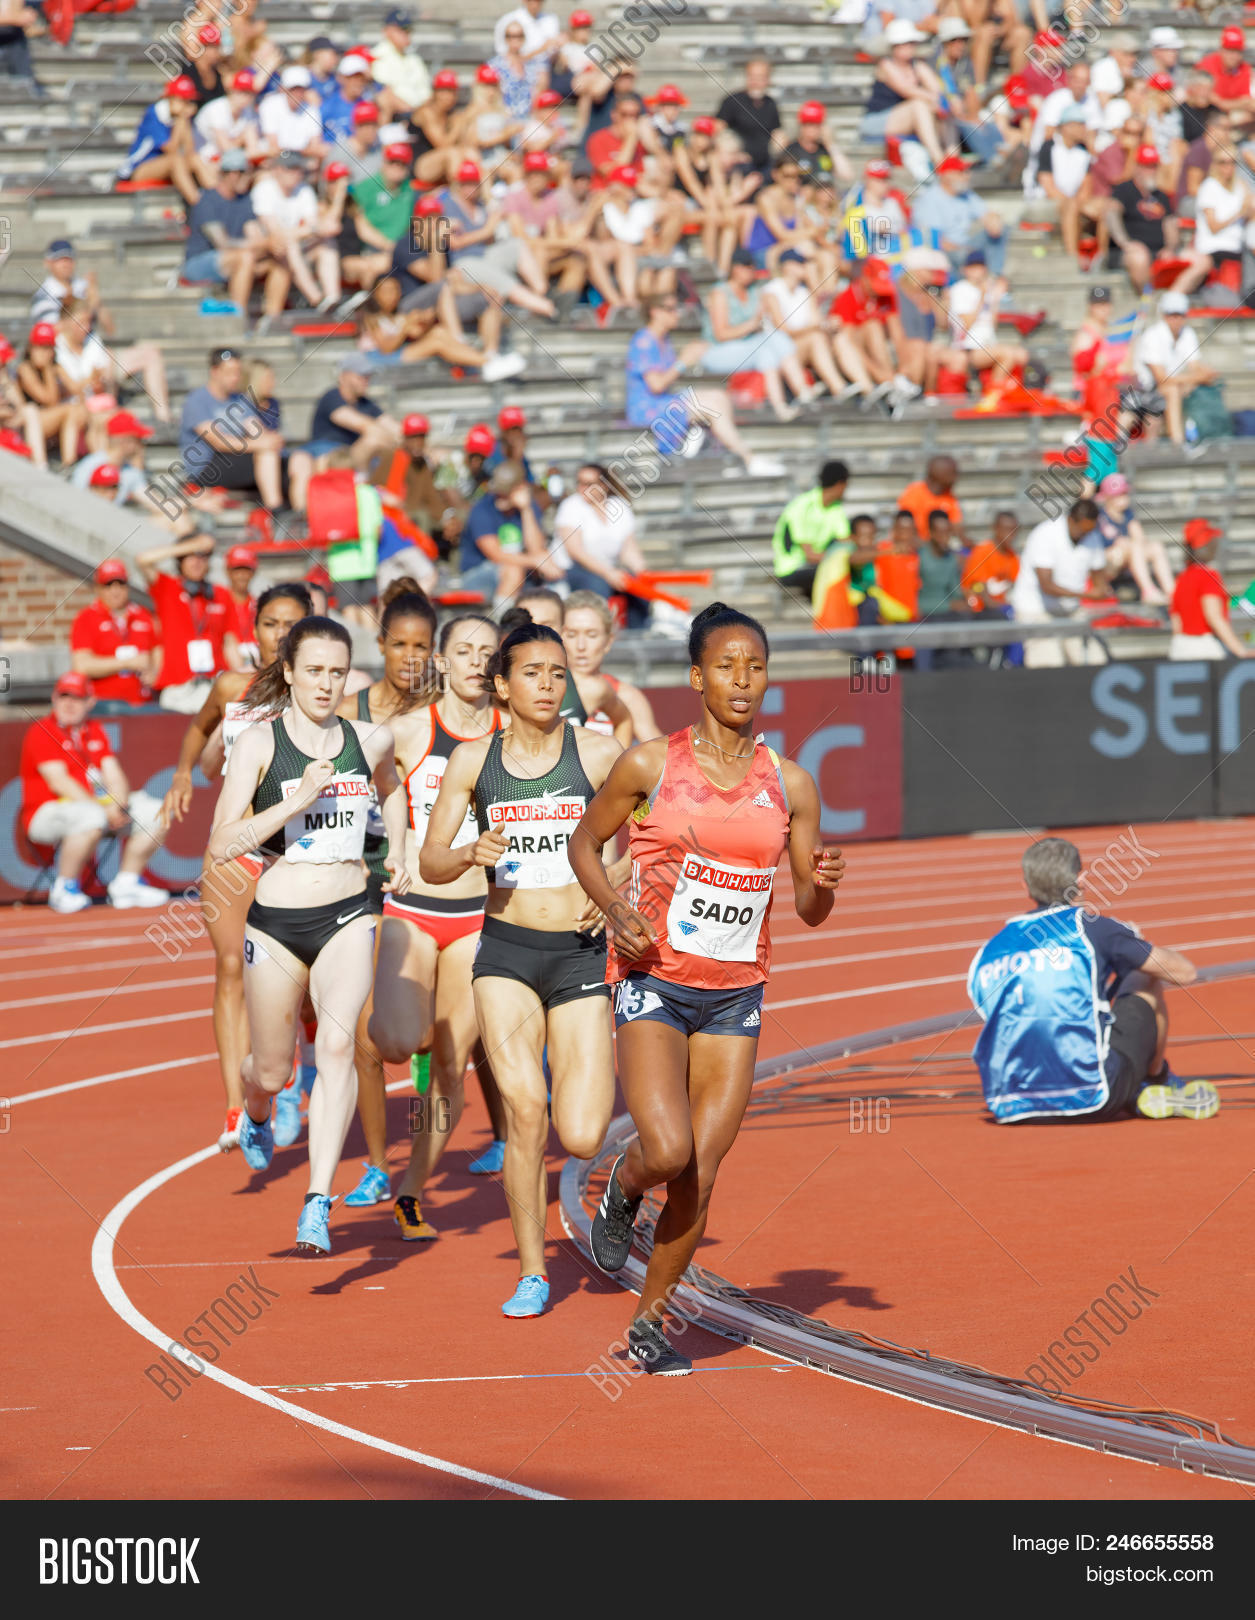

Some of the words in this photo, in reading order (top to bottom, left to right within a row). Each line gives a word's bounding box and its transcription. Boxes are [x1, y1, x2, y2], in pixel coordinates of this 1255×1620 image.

[304, 811, 354, 830] MUIR
[685, 860, 772, 892] BAUHAUS
[689, 898, 753, 925] SADO
[979, 947, 1073, 988] PHOTO
[628, 988, 645, 1014] 3
